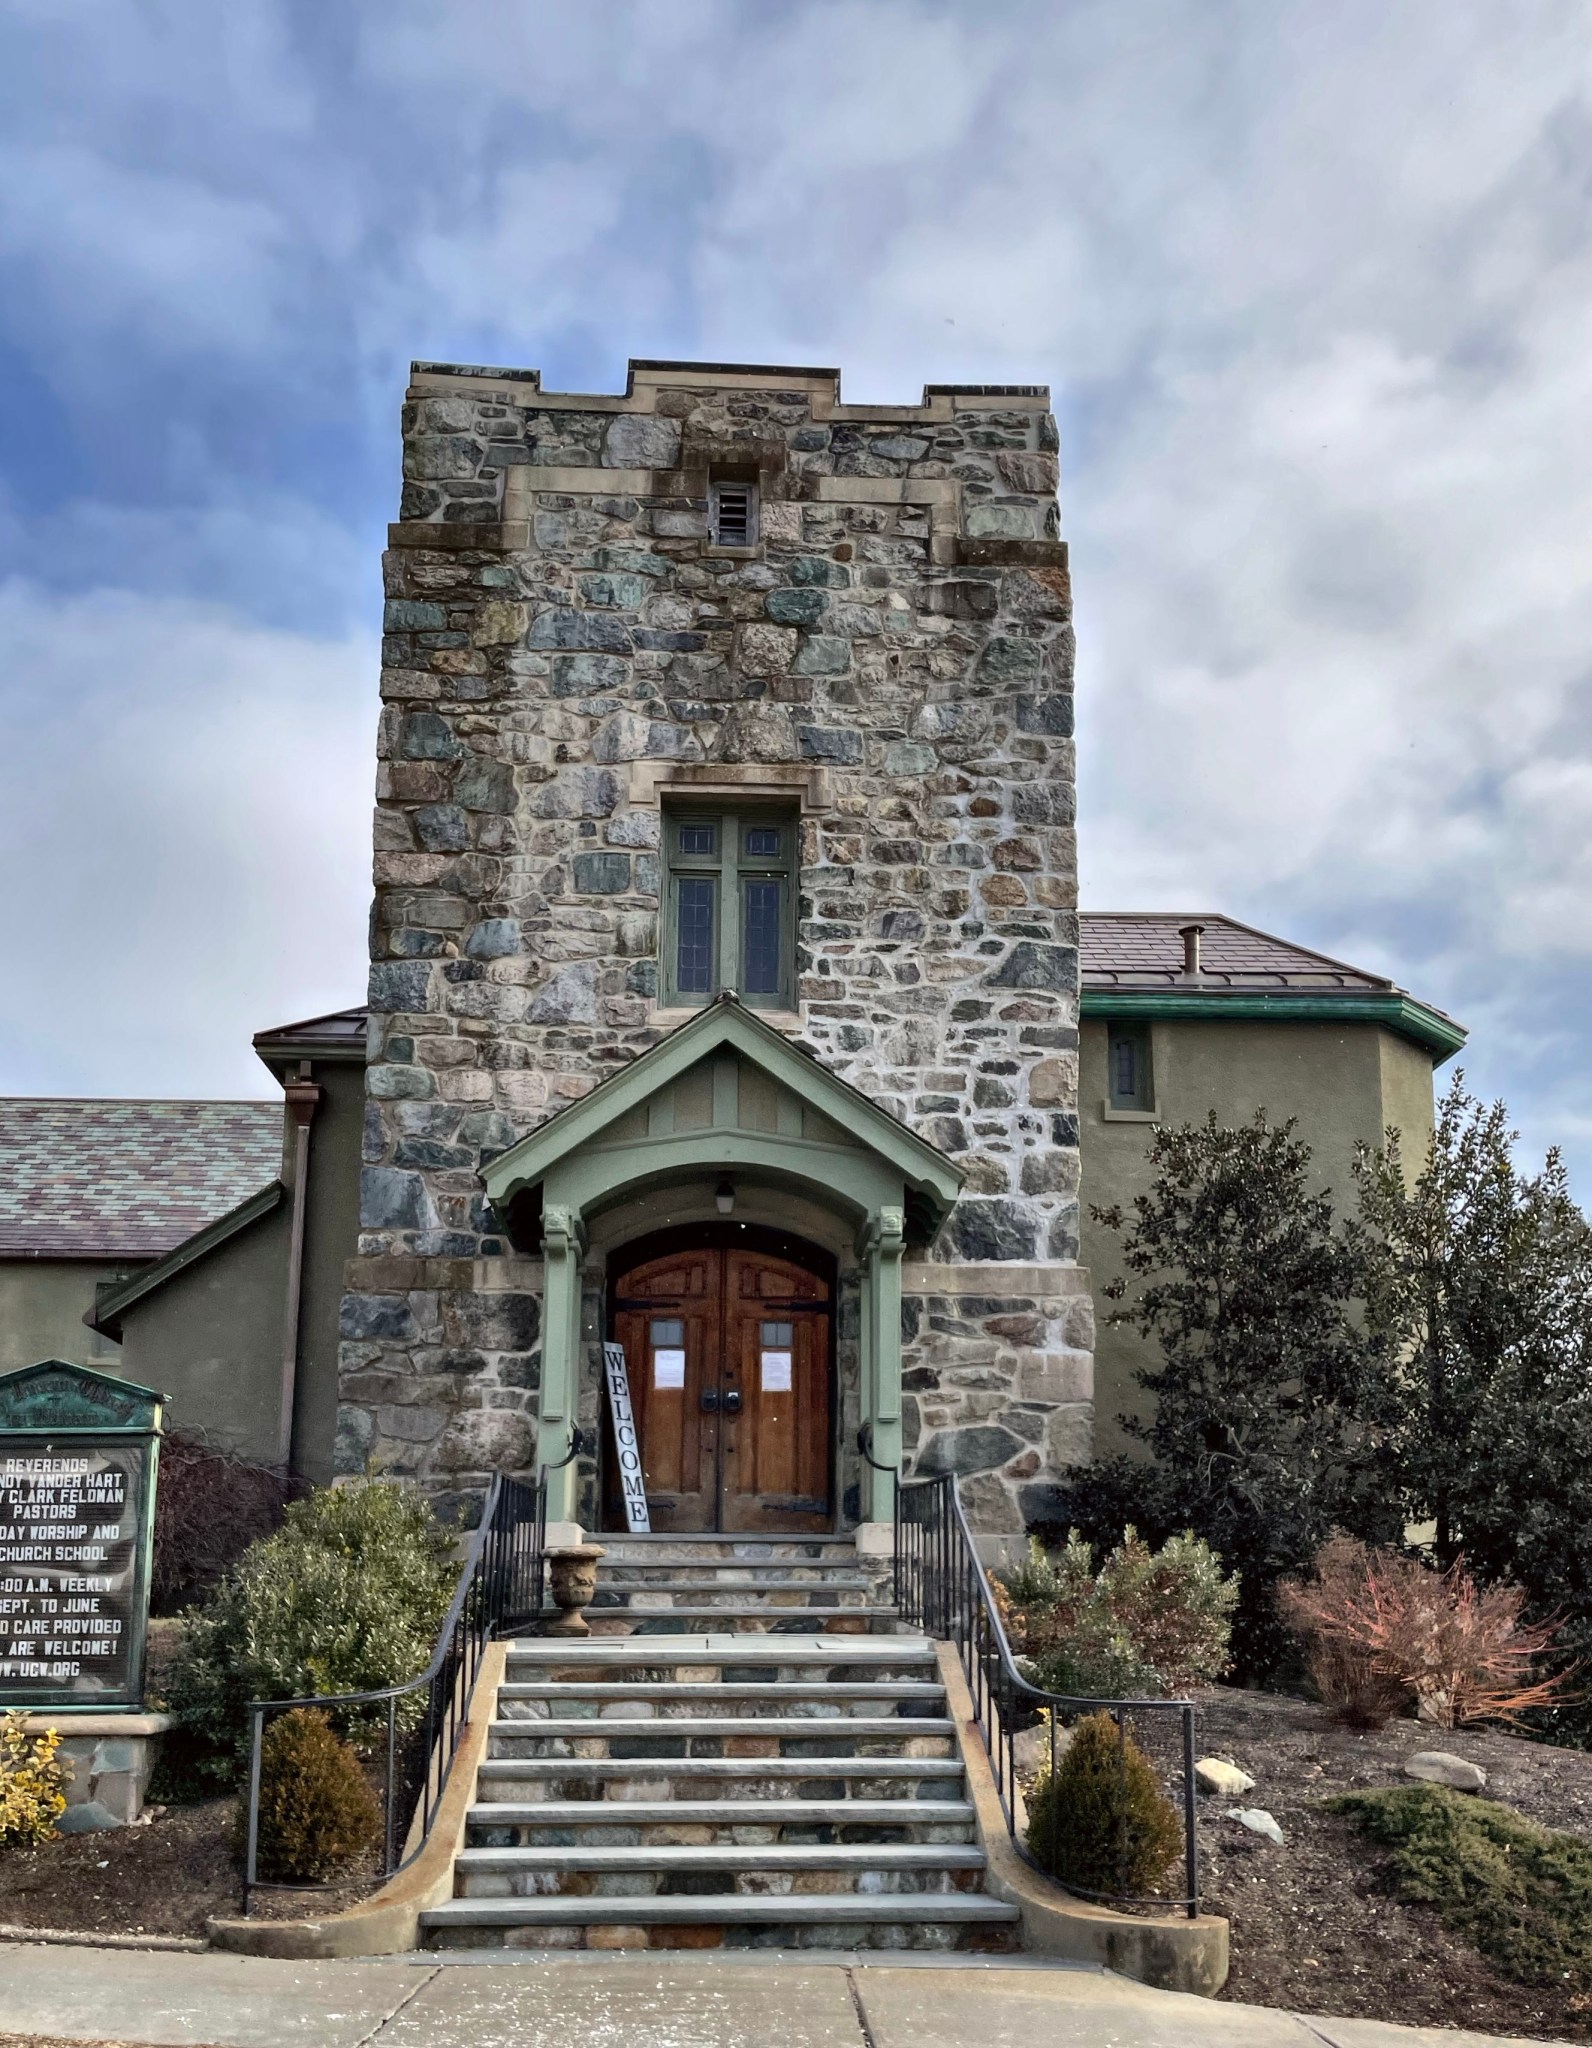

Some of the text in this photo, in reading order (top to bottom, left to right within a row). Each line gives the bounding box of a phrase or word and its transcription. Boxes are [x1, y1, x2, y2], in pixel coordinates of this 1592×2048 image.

[605, 1350, 647, 1522] WELCOME
[6, 1458, 89, 1473] REVERENDS
[29, 1473, 81, 1488] VANDER
[86, 1473, 122, 1488] HART
[9, 1489, 55, 1504] CLARK
[60, 1488, 124, 1503] FELDMAN
[13, 1504, 77, 1519] PASTORS
[0, 1525, 120, 1540] DAY WORSHIP AND
[0, 1546, 109, 1561] CHURCH SCHOOL
[26, 1578, 53, 1593] A.M.
[60, 1577, 113, 1592] WEEKLY
[0, 1598, 100, 1614] EPT. TO JUNE
[13, 1620, 50, 1635] CARE
[53, 1619, 122, 1634] PROVIDED
[9, 1641, 37, 1656] ARE
[44, 1640, 118, 1655] WELCOME!
